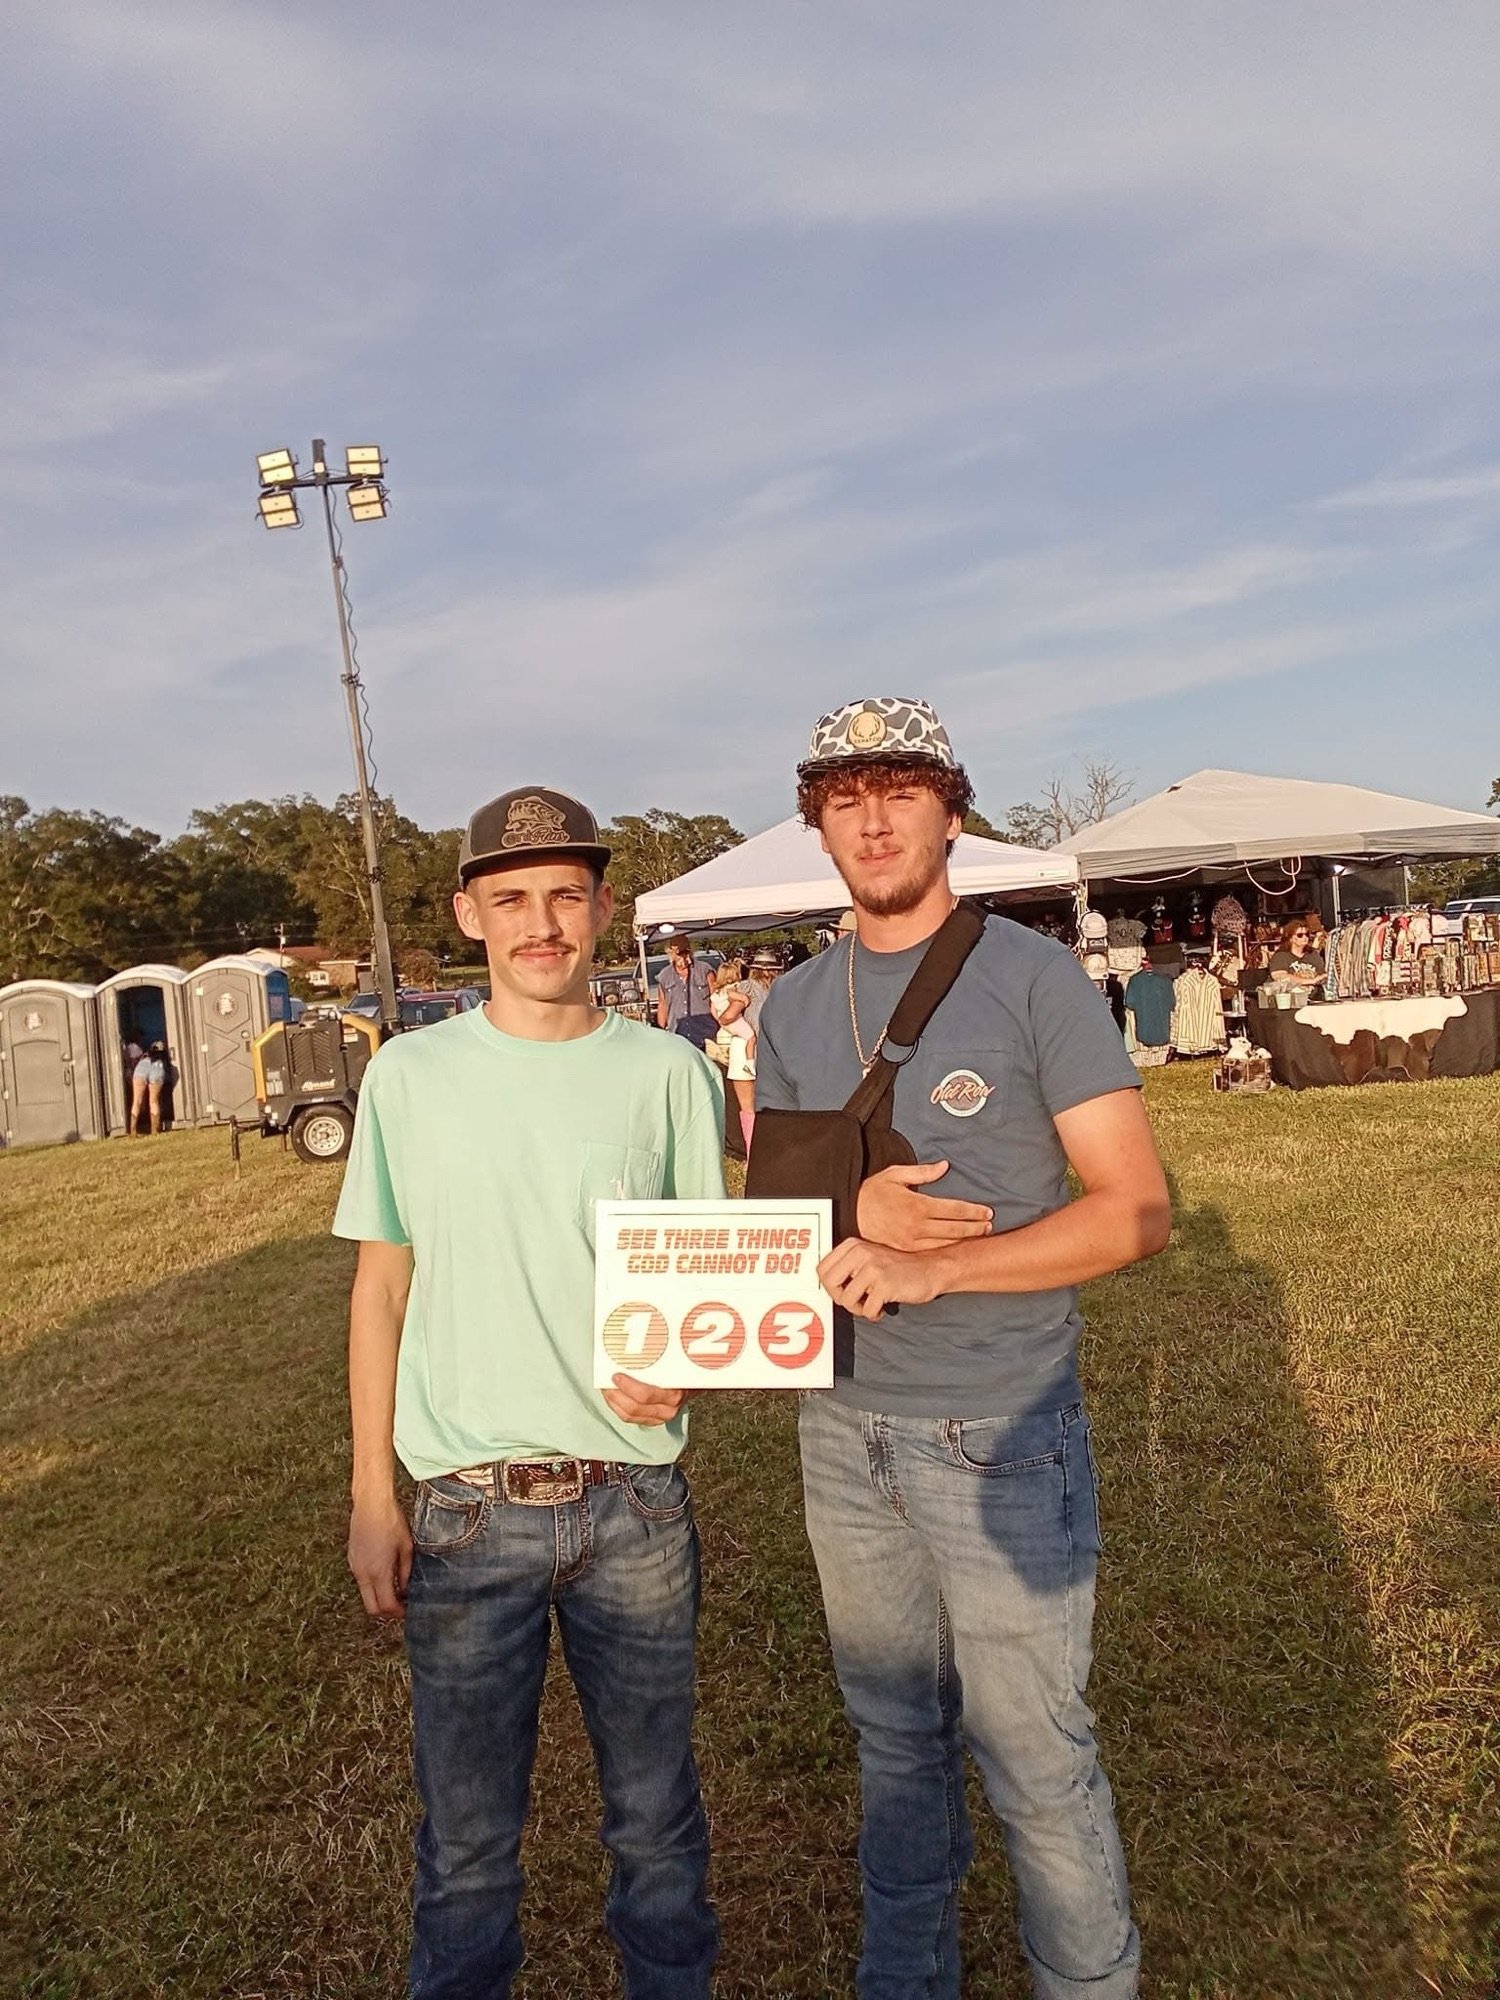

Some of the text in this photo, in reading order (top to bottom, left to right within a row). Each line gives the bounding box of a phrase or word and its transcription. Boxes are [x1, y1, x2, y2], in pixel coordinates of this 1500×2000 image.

[930, 1081, 997, 1105] Old Row
[617, 1228, 812, 1250] SEE THREE THINGS
[627, 1253, 802, 1274] GOD CANNOT DO!
[622, 1310, 816, 1356] 1 2 3
